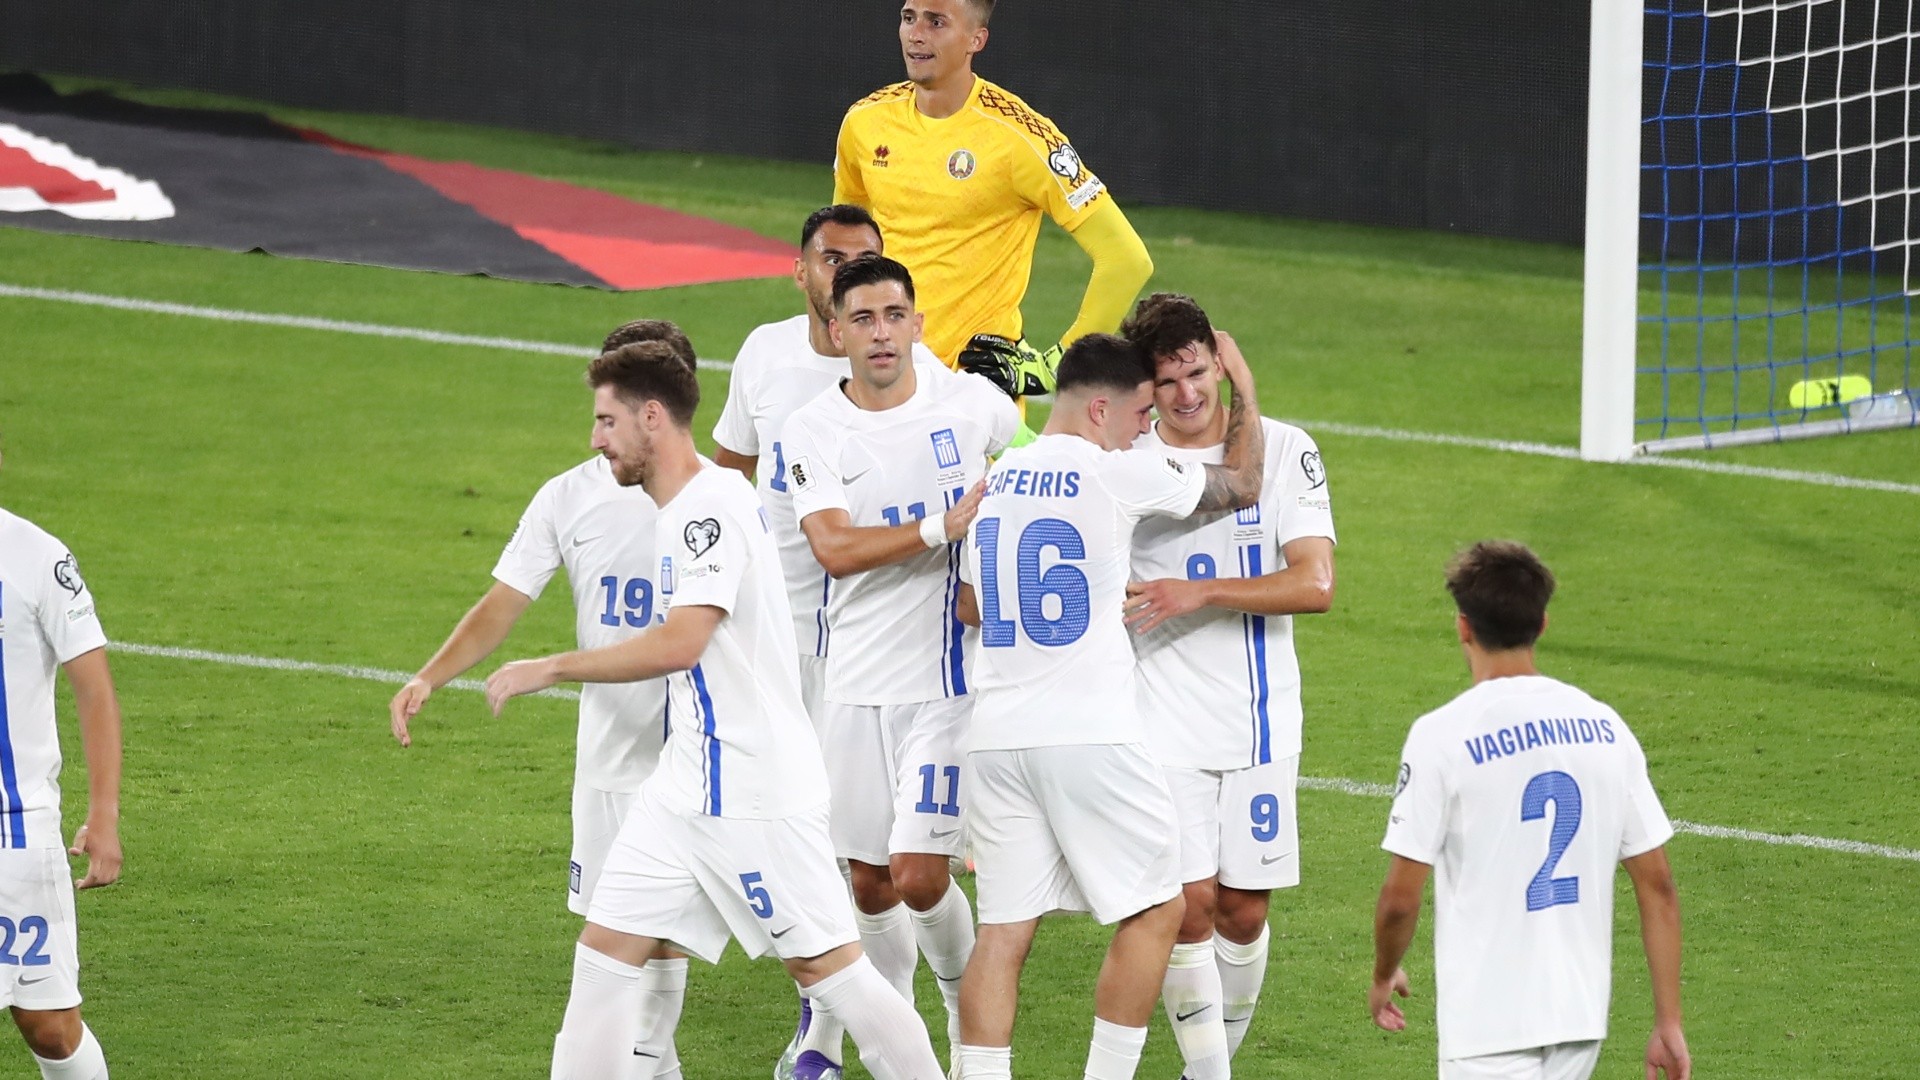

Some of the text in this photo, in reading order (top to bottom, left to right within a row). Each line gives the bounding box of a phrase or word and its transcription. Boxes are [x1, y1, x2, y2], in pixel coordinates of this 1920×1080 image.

[983, 469, 1080, 498] ZAFEIRIS
[600, 576, 654, 628] 19
[975, 517, 1090, 647] 16
[1464, 718, 1616, 765] VAGIANNIDIS
[915, 763, 960, 817] 11
[1250, 793, 1278, 842] 9
[1521, 770, 1582, 912] 2
[738, 871, 774, 919] 5
[0, 916, 51, 966] 22
